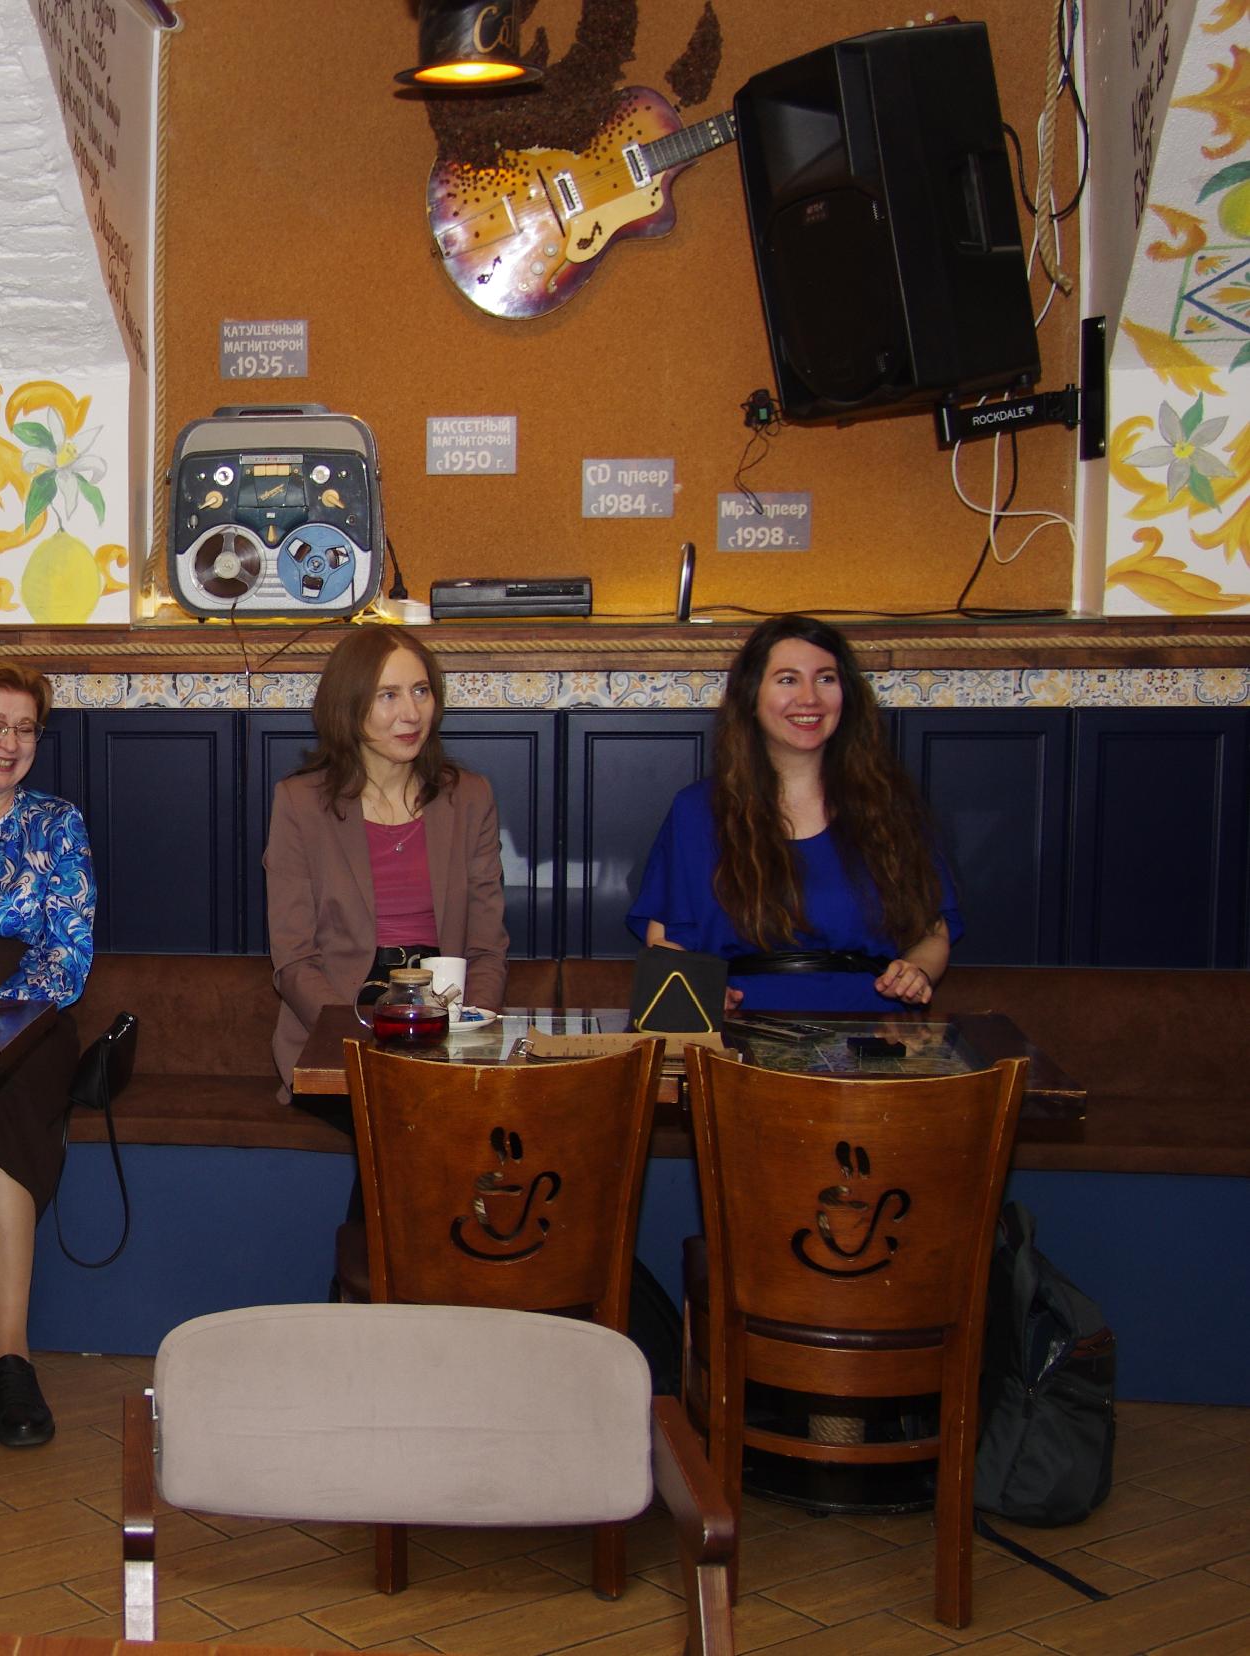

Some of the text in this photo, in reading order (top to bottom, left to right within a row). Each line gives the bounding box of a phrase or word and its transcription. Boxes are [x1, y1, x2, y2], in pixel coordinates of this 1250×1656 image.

[223, 322, 303, 338] КАТУШЕЧНЫЙ
[223, 339, 303, 354] МАГНИТОФОН
[972, 406, 1026, 426] ROCKDALE
[432, 417, 510, 434] КАССЕТНЫЙ
[432, 435, 511, 448] МАГНИТОФОН
[586, 463, 669, 487] CD плеер
[762, 504, 808, 519] плеер
